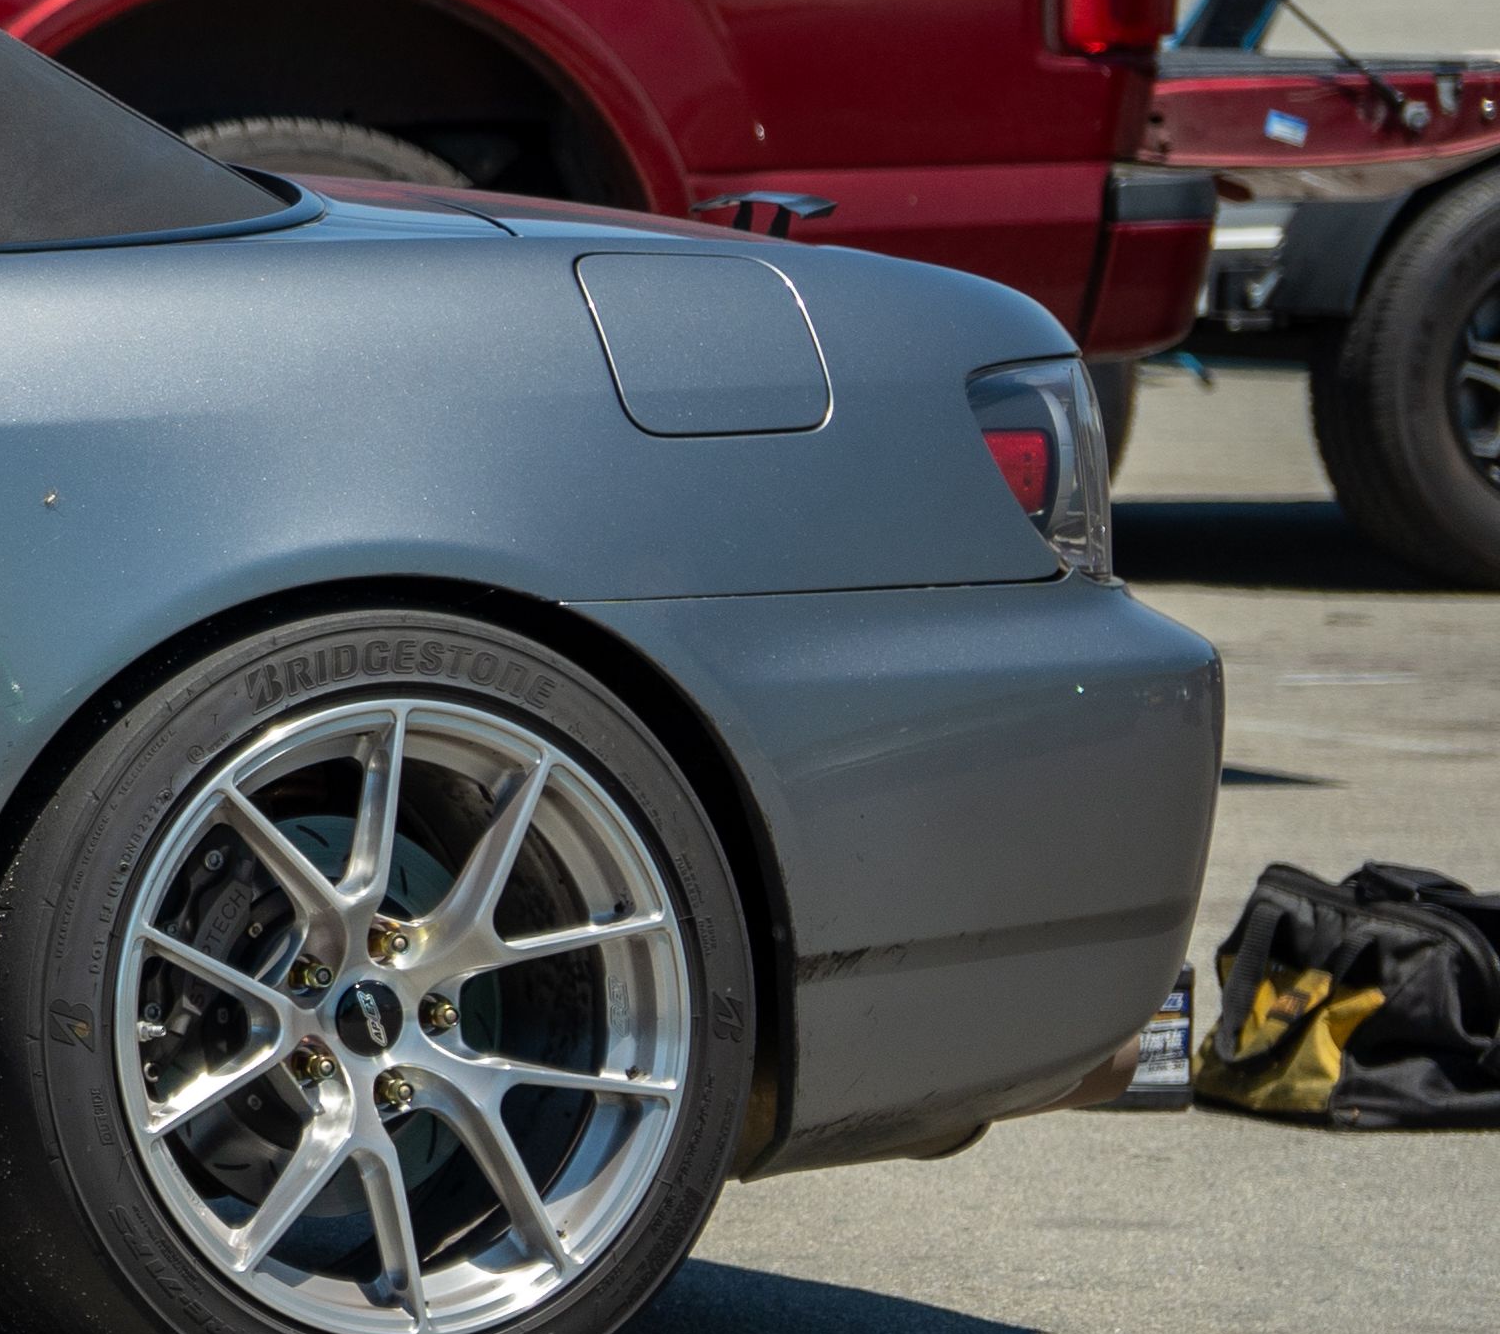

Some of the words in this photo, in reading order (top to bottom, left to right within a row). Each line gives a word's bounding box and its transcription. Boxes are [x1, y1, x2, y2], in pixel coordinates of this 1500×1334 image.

[237, 634, 559, 716] BRIDGESTONE
[188, 888, 248, 1009] STTECH
[355, 989, 389, 1048] APEX
